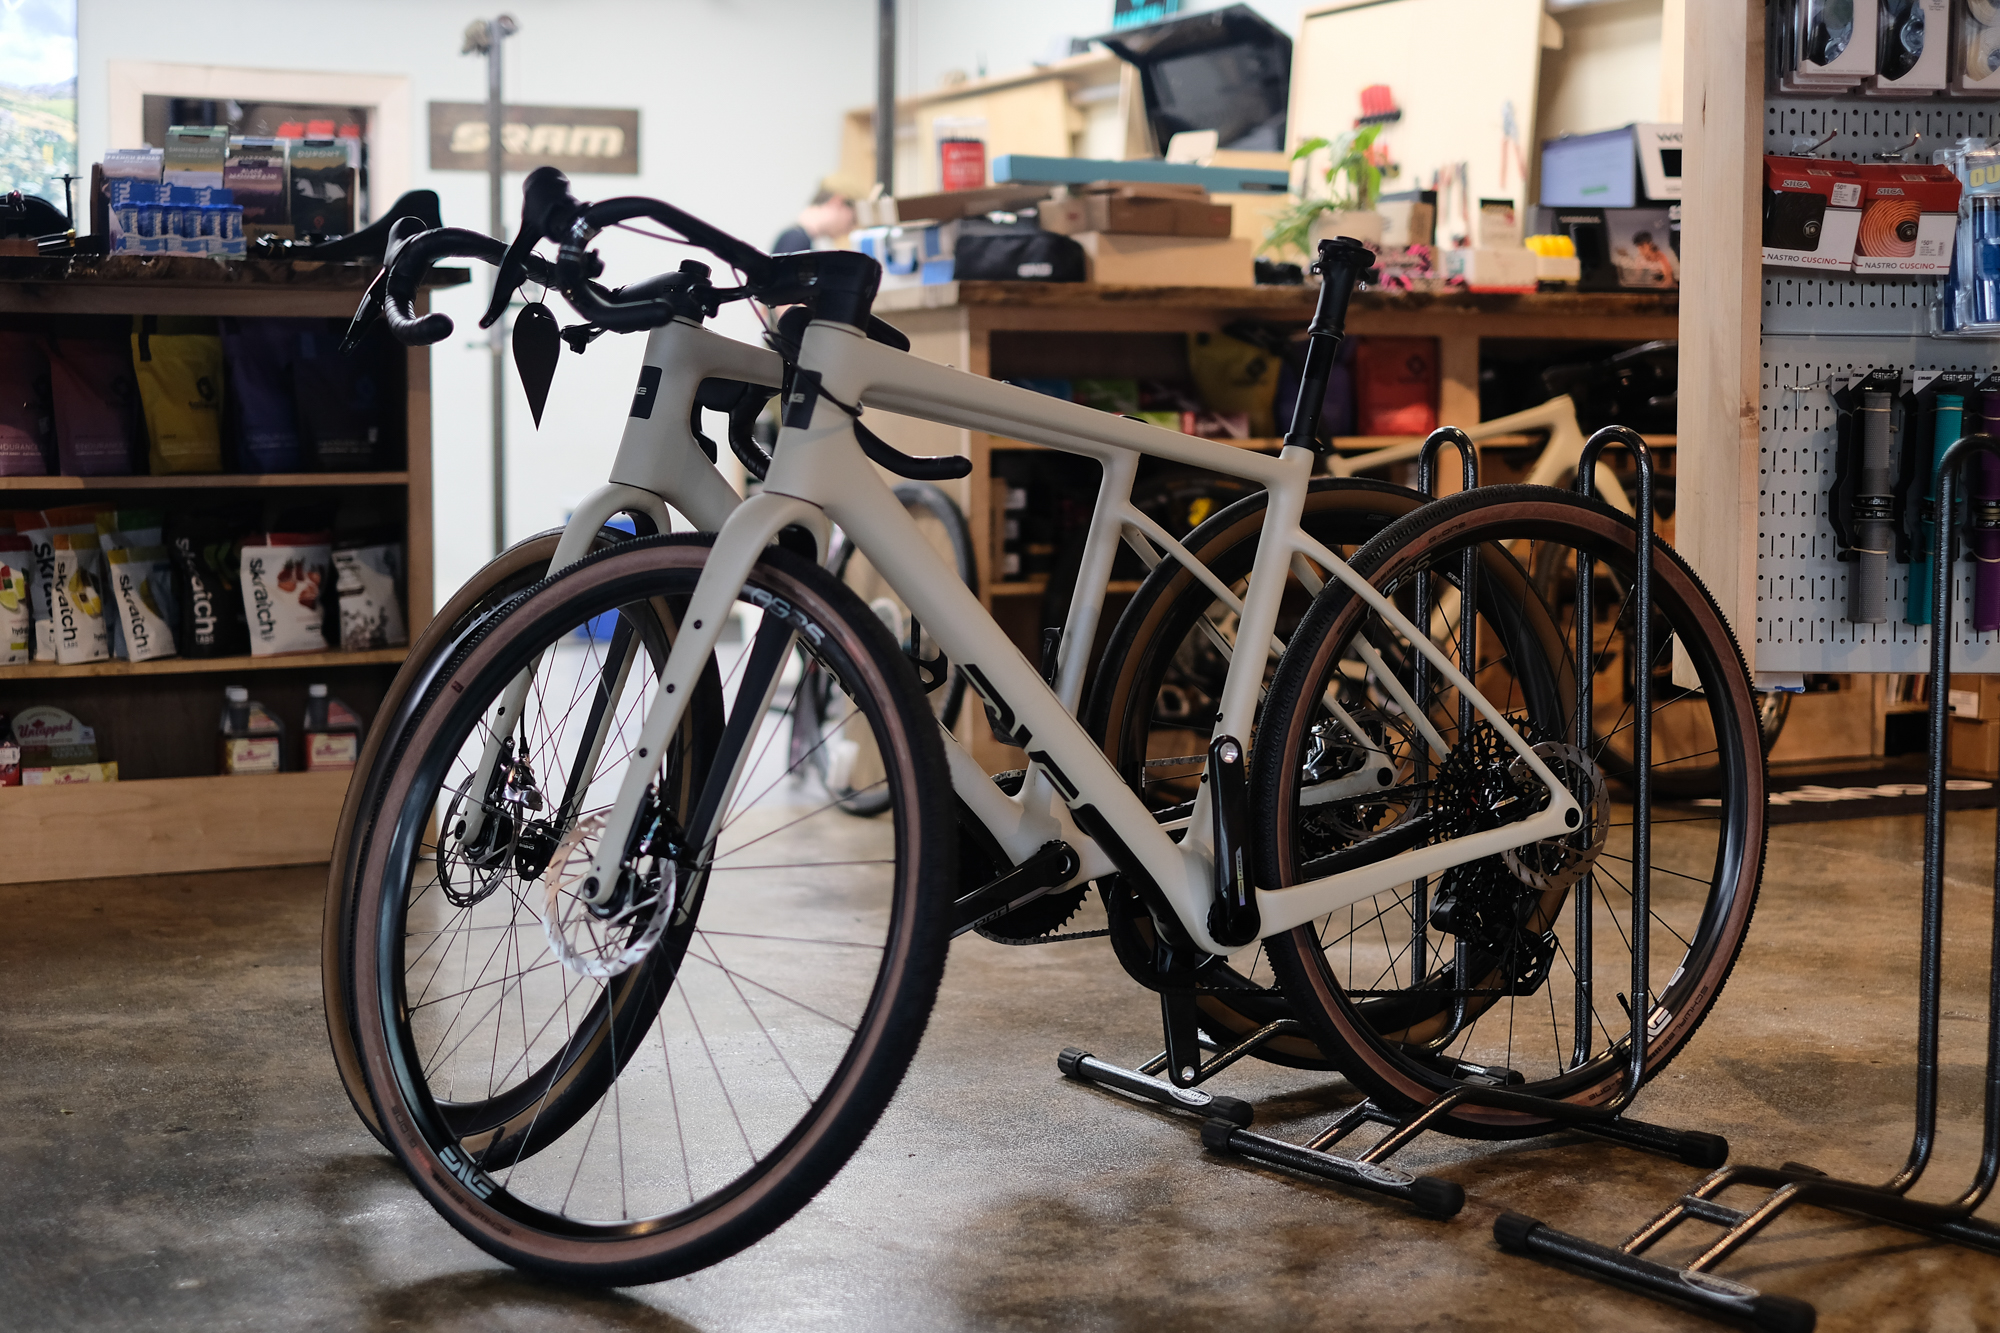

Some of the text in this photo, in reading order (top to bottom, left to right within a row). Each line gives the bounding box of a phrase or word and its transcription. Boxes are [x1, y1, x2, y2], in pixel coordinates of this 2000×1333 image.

[450, 121, 625, 158] SRAM
[297, 150, 340, 158] DUPONT
[1766, 253, 1838, 265] NASTRO CUSCINO
[1899, 262, 1936, 270] CUSCINO
[17, 717, 74, 739] Untapped
[1661, 984, 1709, 1047] SCHWALBE
